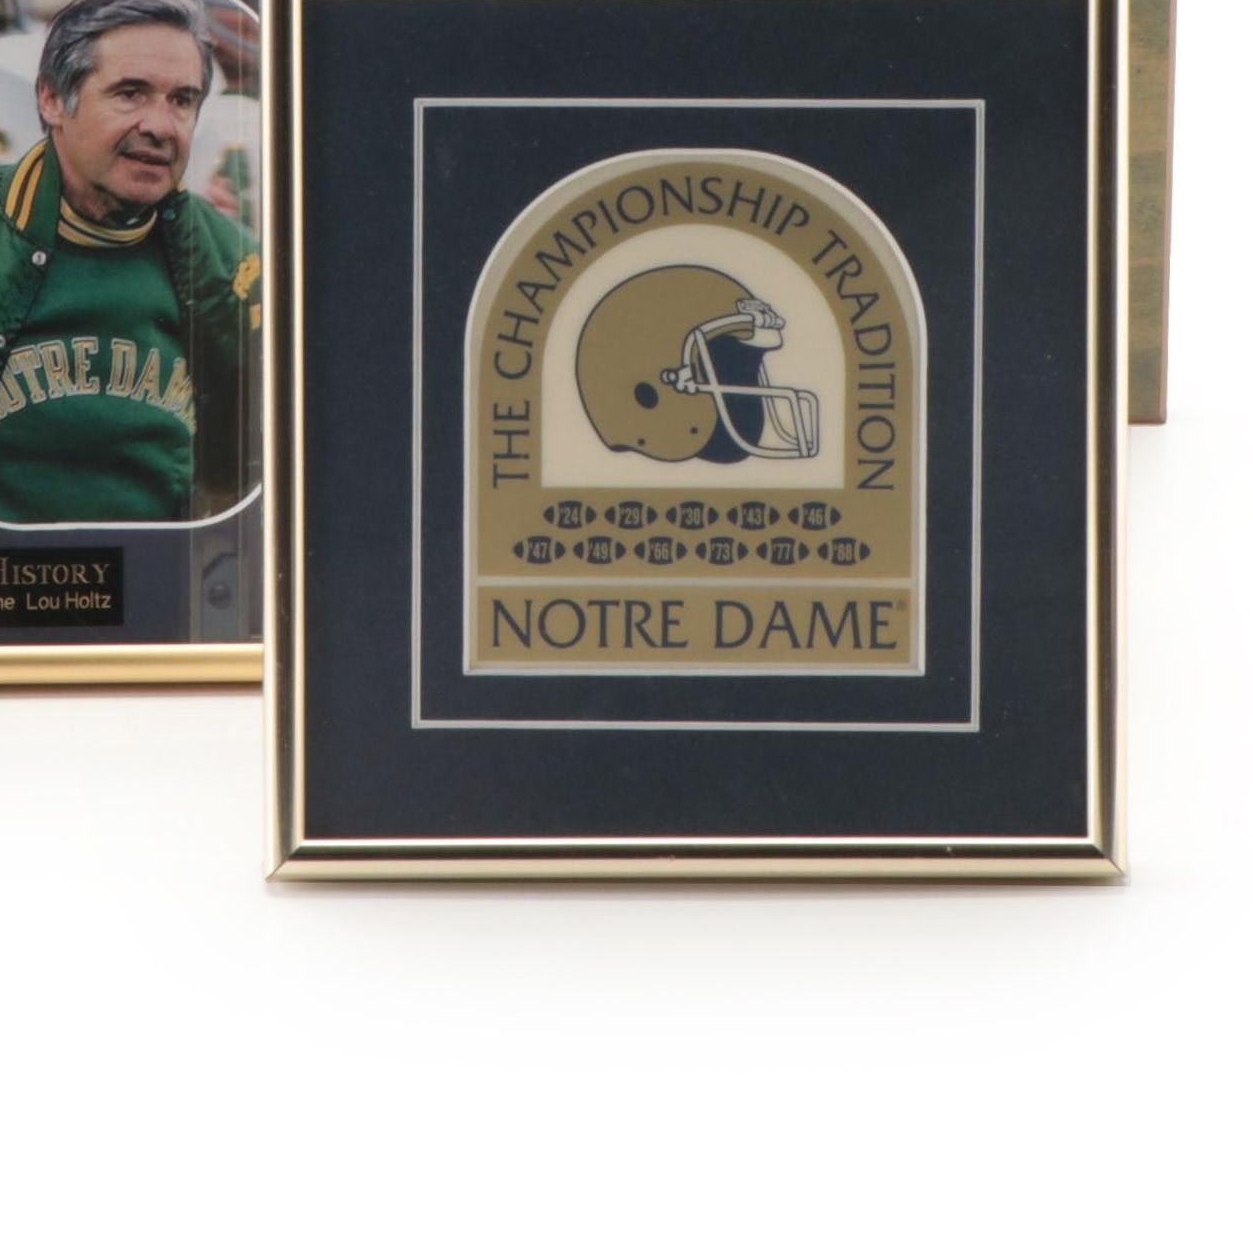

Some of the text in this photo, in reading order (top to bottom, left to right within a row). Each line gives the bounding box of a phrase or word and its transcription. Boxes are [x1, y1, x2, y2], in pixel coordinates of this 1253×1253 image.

[492, 175, 896, 492] THE CHAMPIONSHIP TRADITION
[106, 336, 197, 436] DAM
[559, 507, 580, 525] '24
[773, 544, 792, 561] '77
[26, 592, 60, 610] Lou
[65, 591, 112, 609] Holtz
[491, 598, 897, 650] NOTRE DAME
